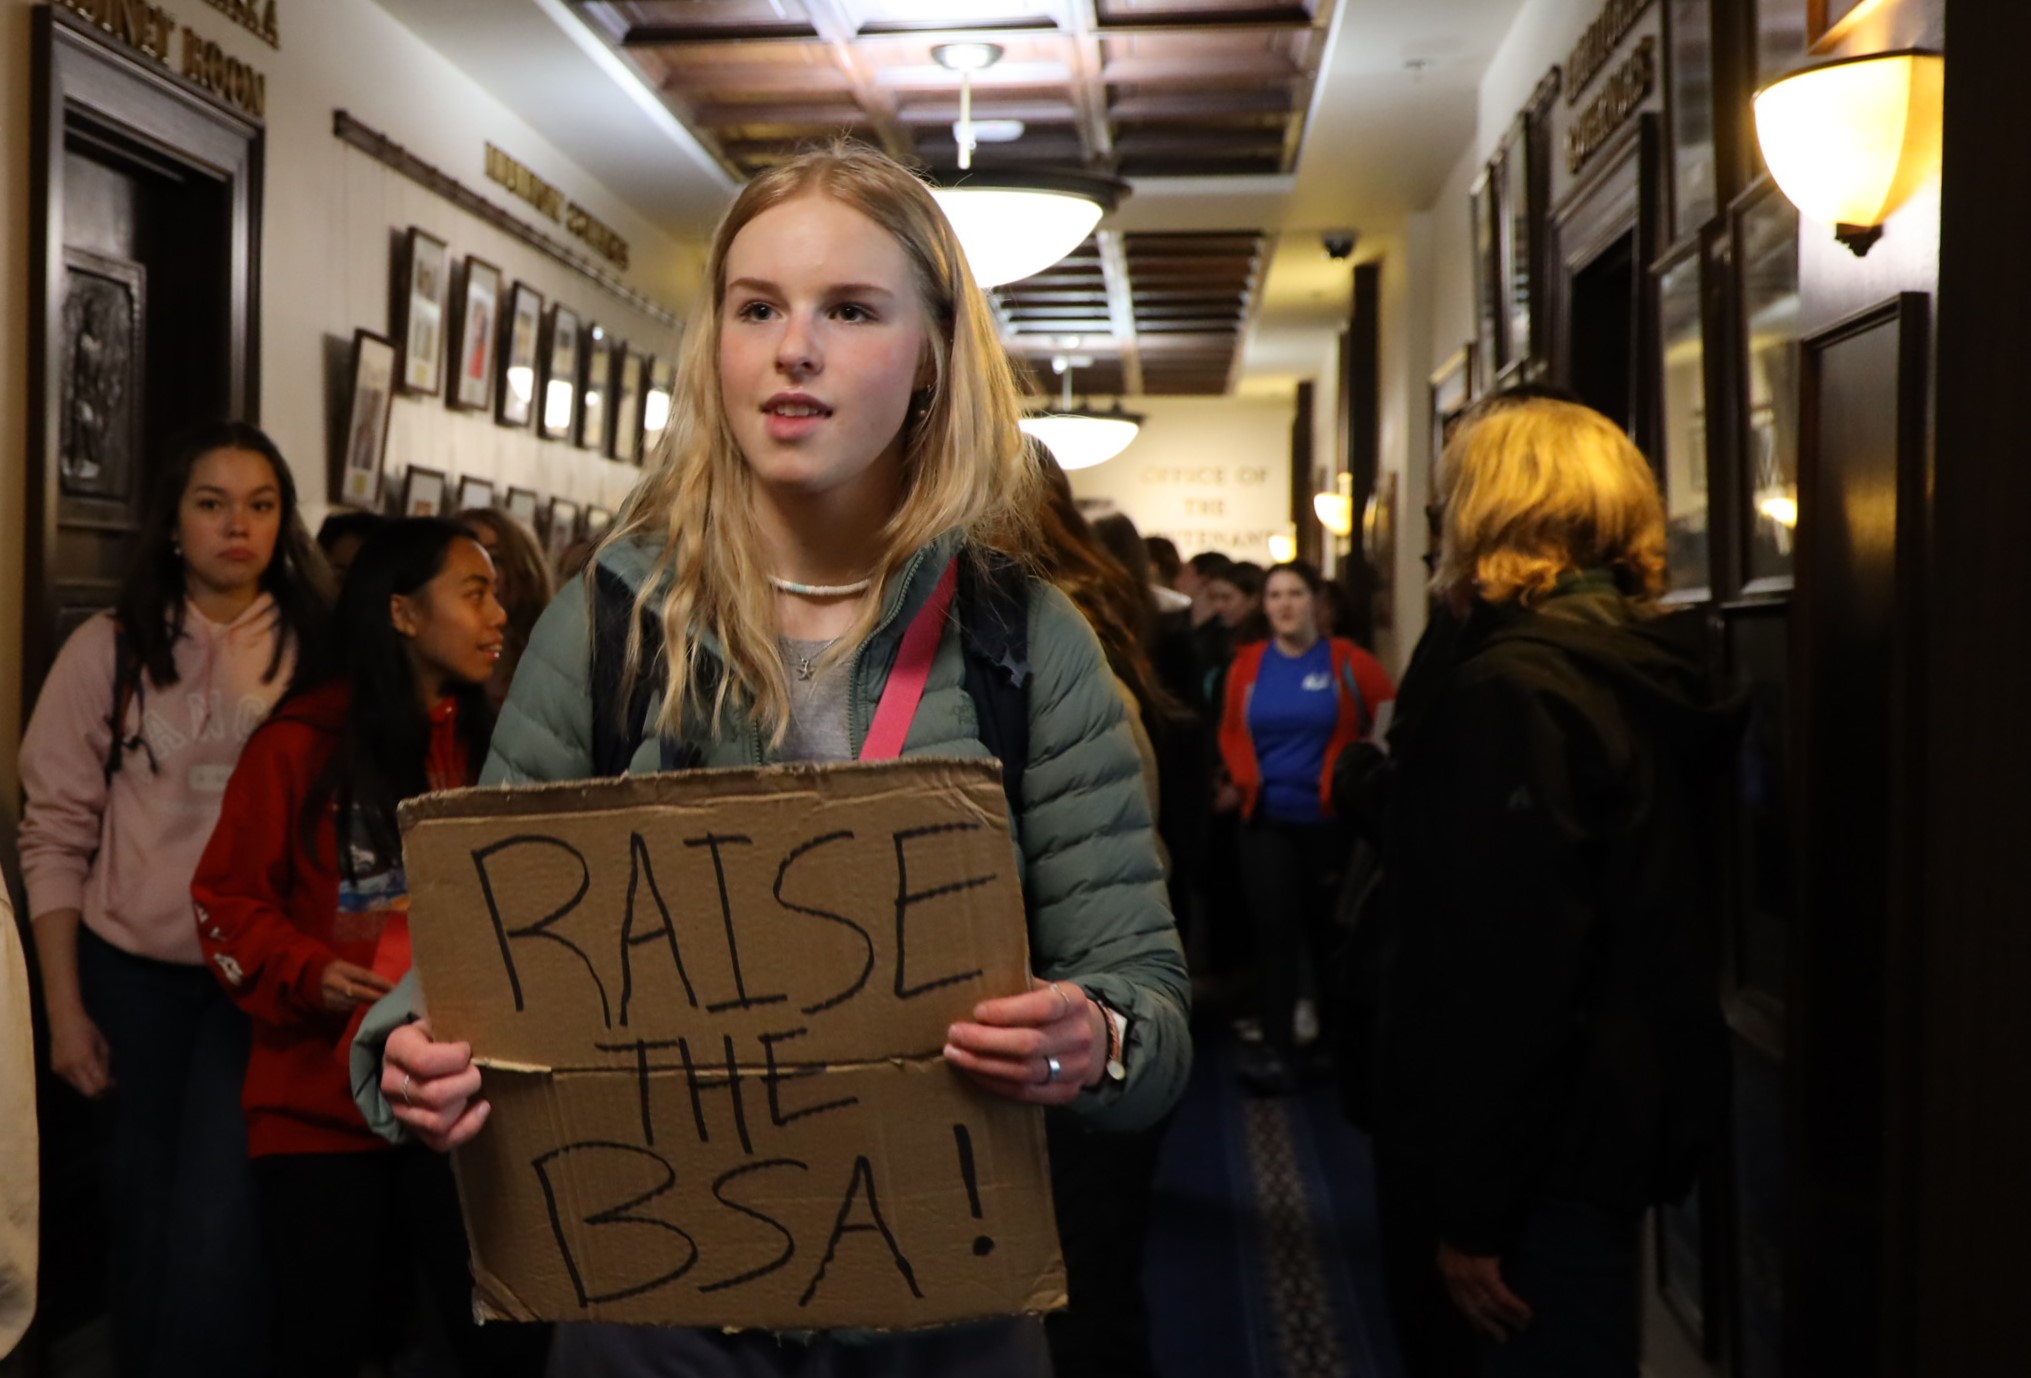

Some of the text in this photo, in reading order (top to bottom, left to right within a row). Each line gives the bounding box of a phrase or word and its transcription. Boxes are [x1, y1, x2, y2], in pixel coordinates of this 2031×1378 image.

[1140, 466, 1270, 485] OFFICE OF
[1184, 498, 1225, 516] THE
[471, 821, 998, 1028] RAISE
[594, 1027, 859, 1155] THE
[531, 1123, 996, 1309] BSA!
